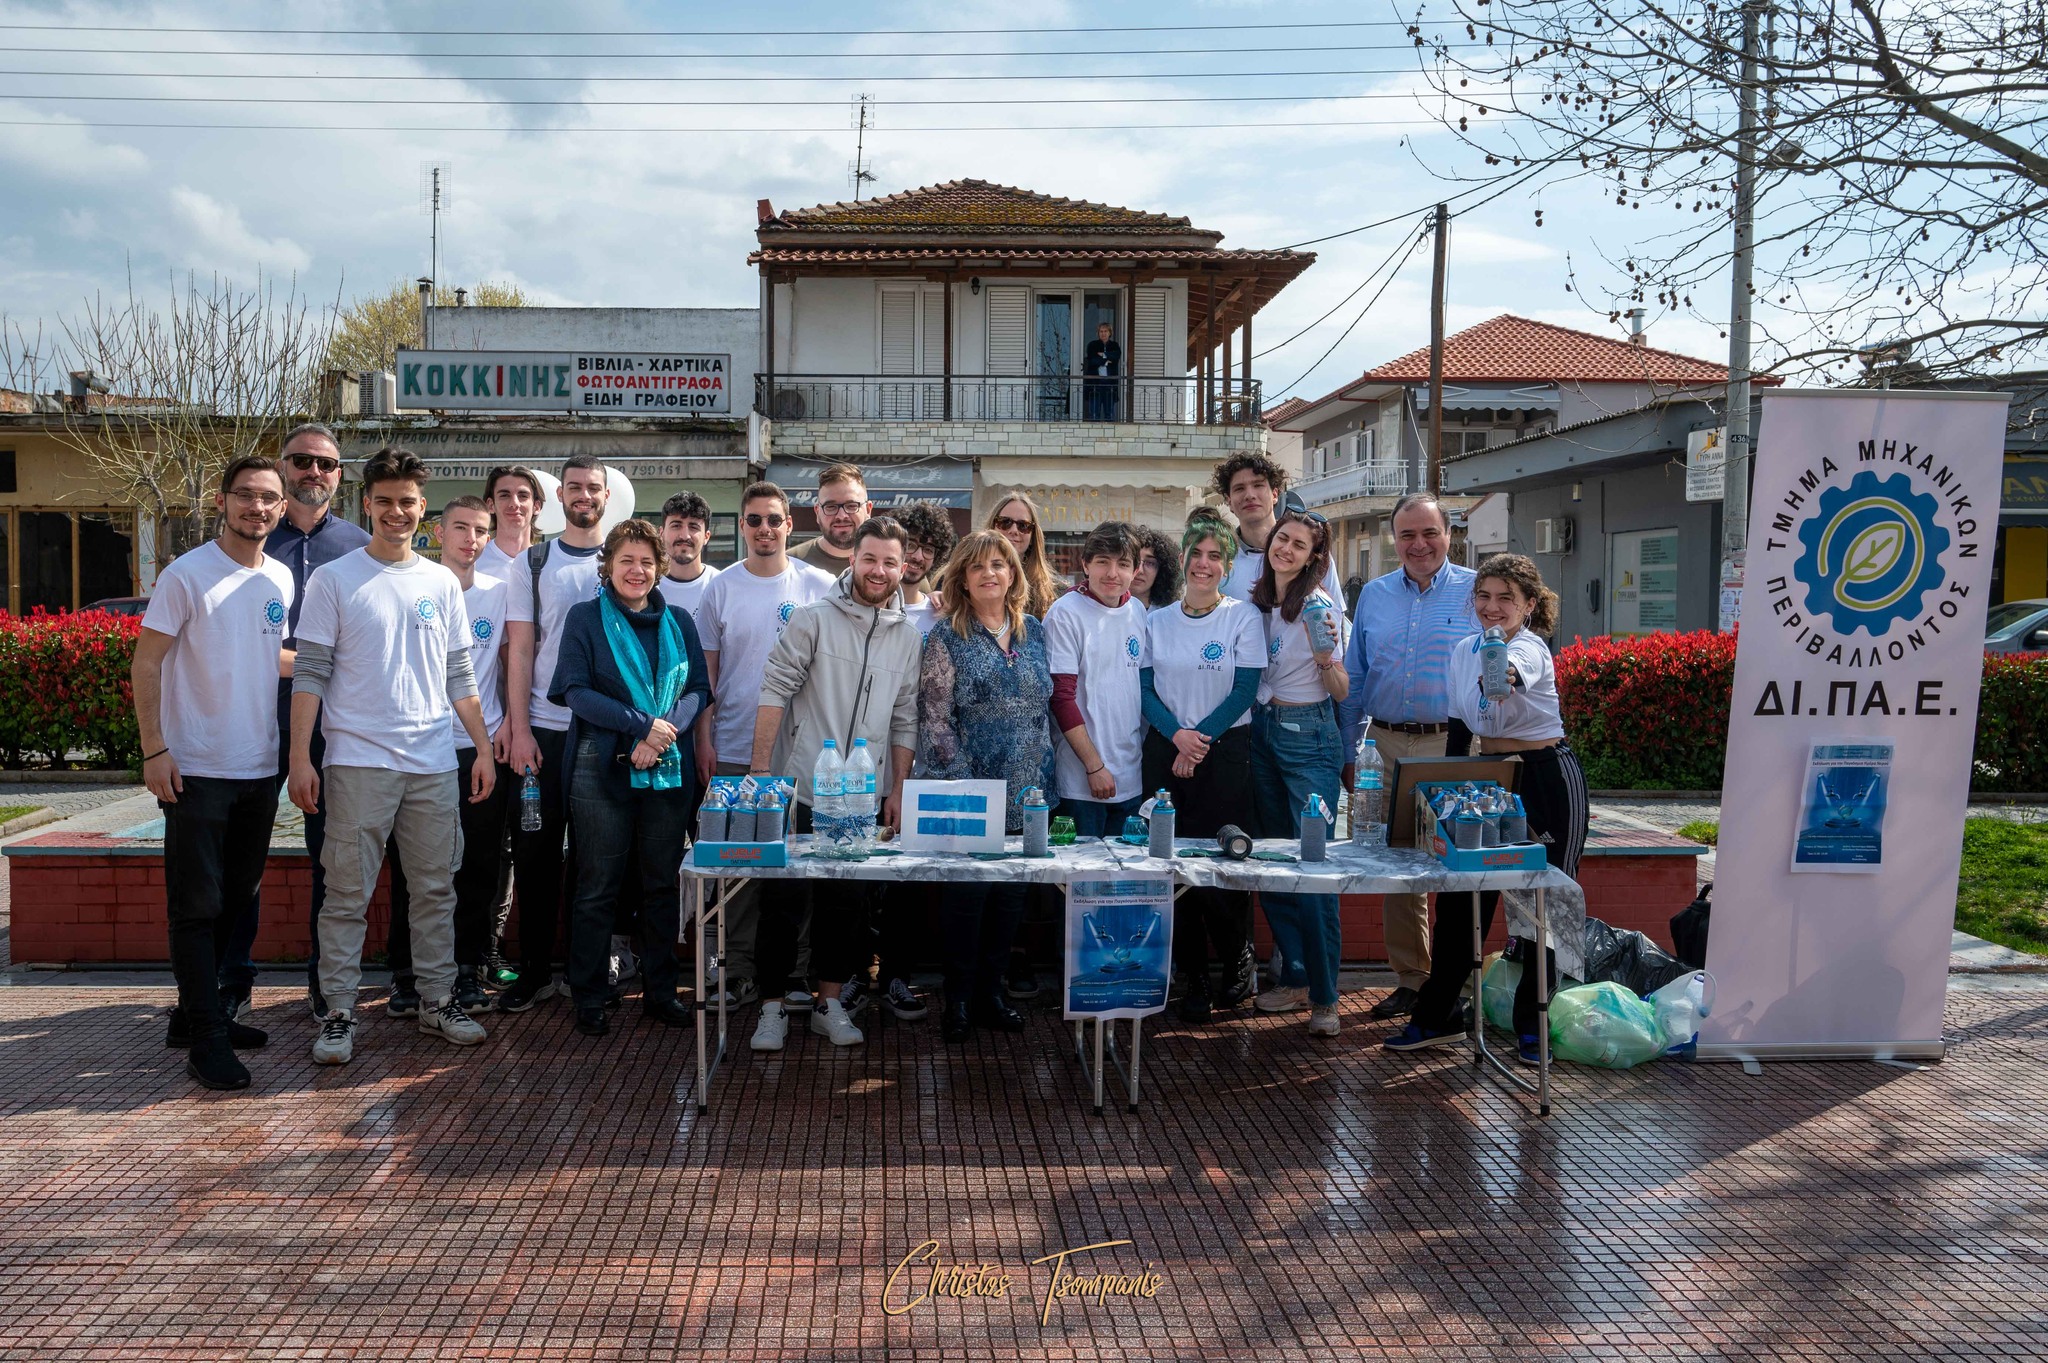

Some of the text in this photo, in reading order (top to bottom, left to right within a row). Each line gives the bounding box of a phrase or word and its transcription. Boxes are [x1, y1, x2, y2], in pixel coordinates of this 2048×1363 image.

[578, 357, 635, 373] ΒΙΒΛΙΑ
[648, 358, 723, 373] ΧΑΡΤΙΚΑ
[403, 364, 570, 397] ΚΟΚΚΙΝΗΣ
[577, 375, 723, 390] ΦΩΤΟΑΝΤΙΓΡΑΦΑ
[584, 393, 718, 407] ΕΙΔΗ ΓΡΑΦΕΙΟΥ
[428, 466, 494, 477] ΤΟΤΥΠΙΕ
[1766, 439, 1978, 559] ΤΜΗΜΑ ΜΗΧΑΝΙΚΩΝ
[1766, 576, 1970, 668] ΠΕΡΙΒΑΛΛΟΝΤΟΣ
[1487, 659, 1499, 689] DETOX
[1754, 681, 1957, 716] ΔΙ.ΠΑ.Ε.
